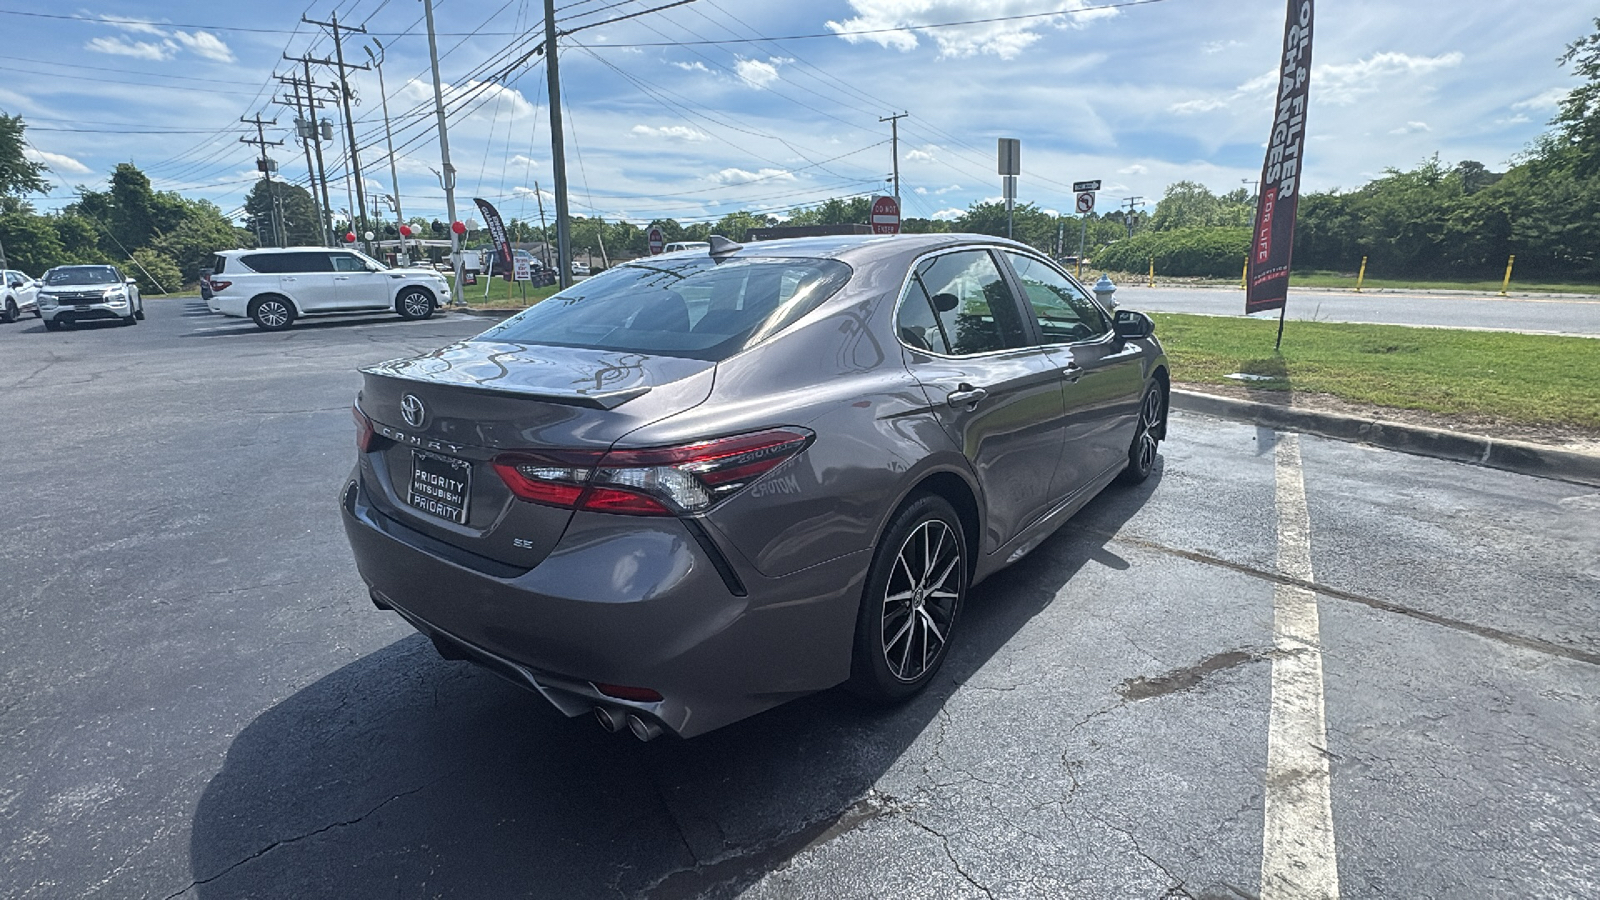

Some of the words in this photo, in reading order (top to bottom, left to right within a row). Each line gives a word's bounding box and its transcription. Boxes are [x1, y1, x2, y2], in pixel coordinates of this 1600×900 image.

[1298, 0, 1310, 60] OIL
[1295, 66, 1306, 89] &
[1266, 25, 1300, 184] CHANGES
[1278, 94, 1304, 200] FILTER
[875, 205, 883, 213] DO
[885, 205, 896, 213] NOT
[1264, 193, 1274, 223] FOR
[877, 225, 895, 233] ENTER
[1260, 228, 1268, 260] LIFE
[383, 427, 463, 453] CAMRY
[414, 469, 464, 493] PRIORITY
[414, 481, 462, 504] MITSUBISHI
[414, 496, 459, 520] PRIORITY
[513, 538, 533, 549] SE
